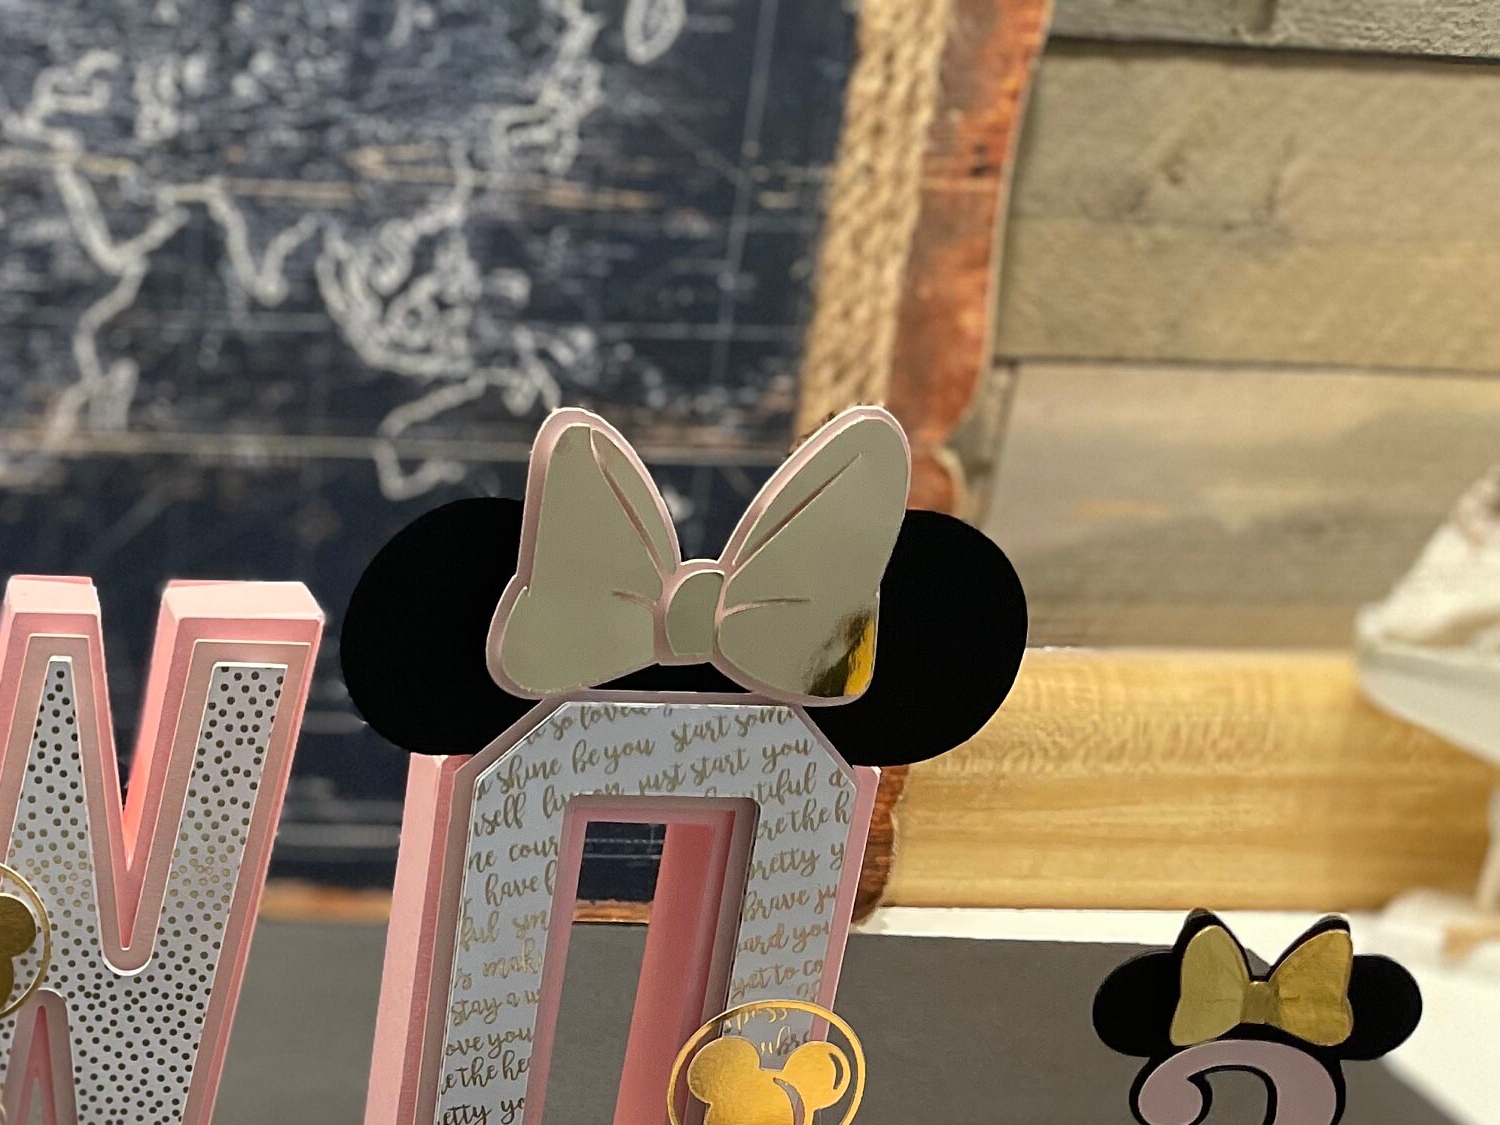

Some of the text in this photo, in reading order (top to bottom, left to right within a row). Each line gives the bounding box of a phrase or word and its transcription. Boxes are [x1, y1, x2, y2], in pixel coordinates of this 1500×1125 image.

[496, 755, 562, 795] shine
[572, 738, 600, 774] be
[604, 738, 657, 774] you
[670, 713, 731, 752] start
[690, 745, 751, 787] start
[761, 738, 815, 774] you
[786, 797, 832, 832] the
[485, 873, 539, 907] have
[450, 998, 502, 1027] stay
[487, 1028, 534, 1060] you
[454, 1056, 498, 1088] the
